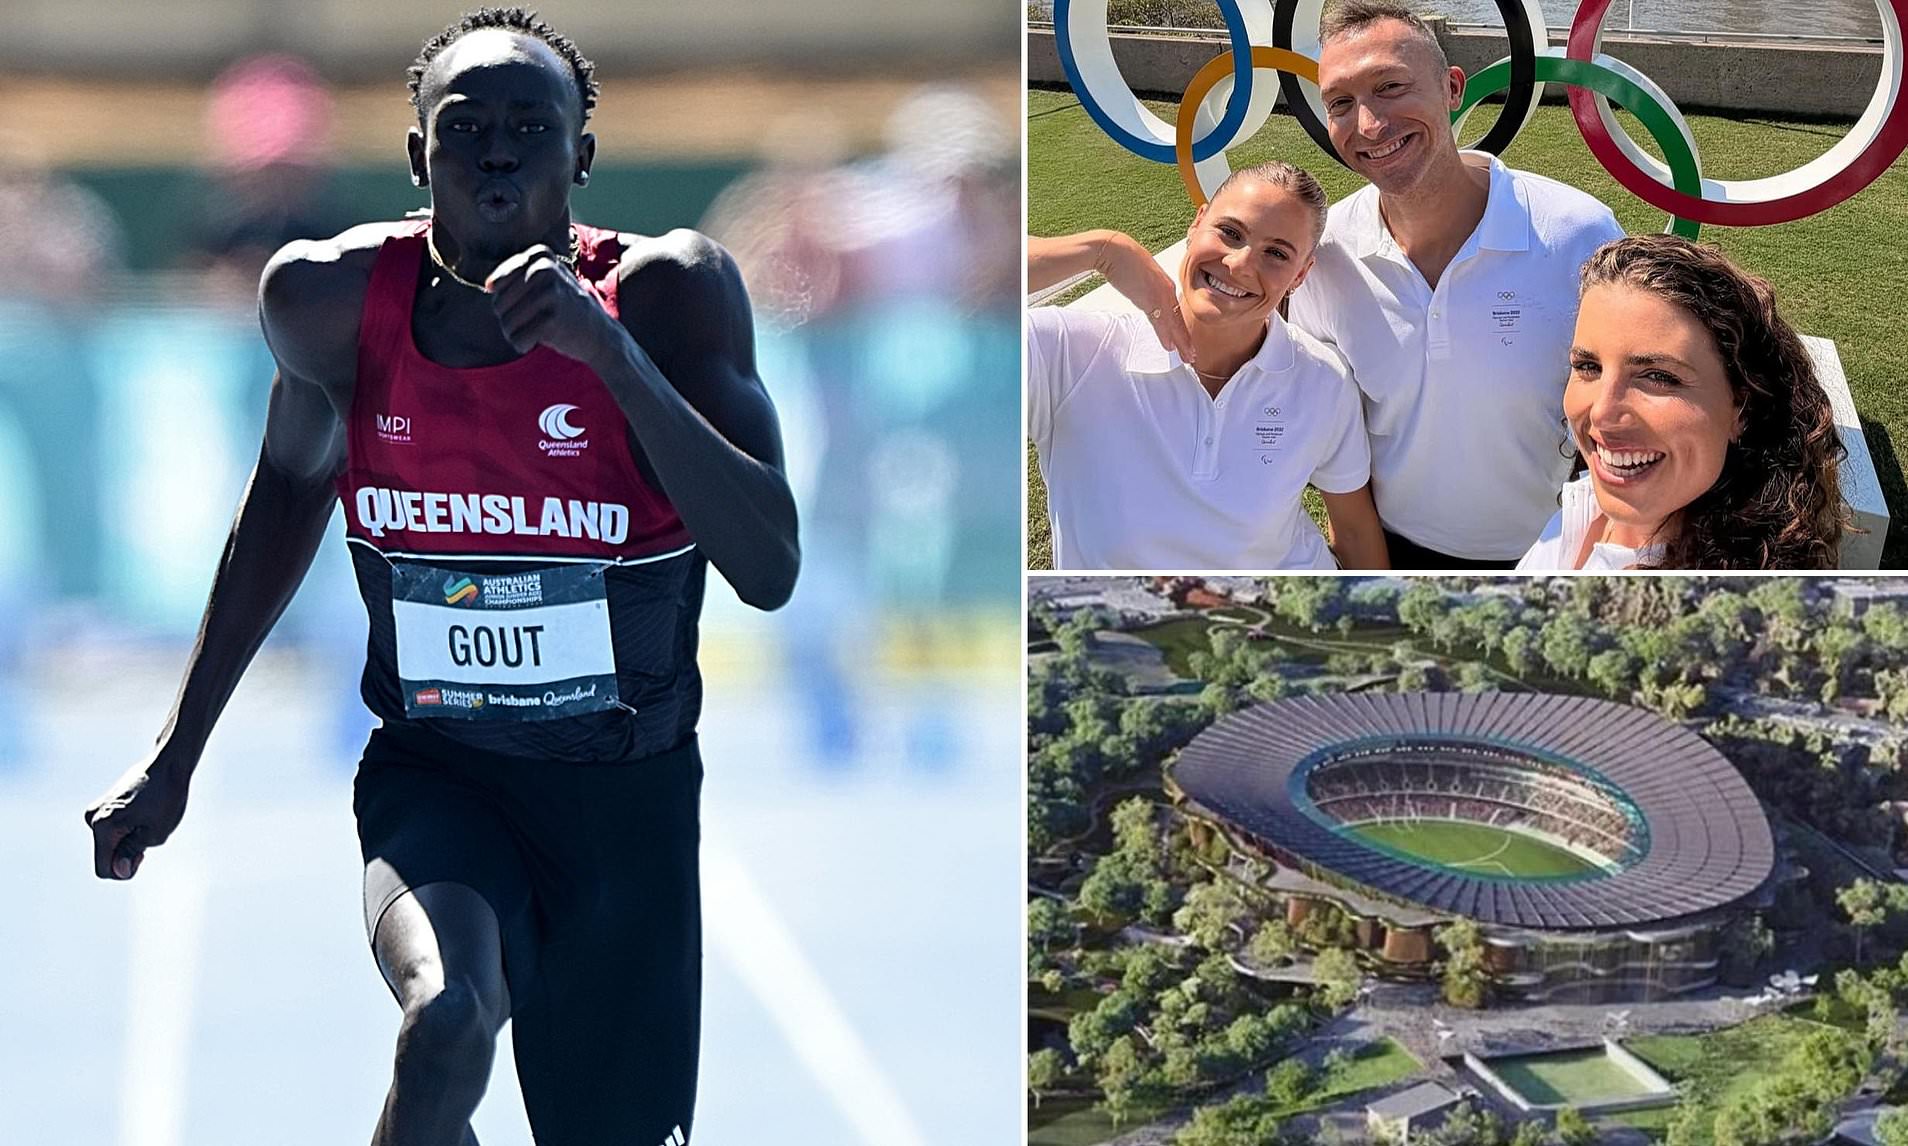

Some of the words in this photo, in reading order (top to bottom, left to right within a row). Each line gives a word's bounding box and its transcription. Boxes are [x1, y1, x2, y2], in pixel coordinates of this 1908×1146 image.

[377, 414, 410, 434] IMPI
[538, 439, 588, 451] Queensland
[547, 448, 580, 457] Athletics
[355, 486, 629, 545] QUEENSLAND
[483, 573, 541, 586] AUSTRALIAN
[484, 582, 541, 594] ATHLETICS
[484, 596, 543, 605] CHAMPIONSHIPS
[448, 625, 544, 668] GOUT
[441, 688, 483, 700] SUMMER
[488, 693, 541, 707] brisbane
[543, 684, 597, 706] Queensland
[442, 697, 473, 708] SERIES
